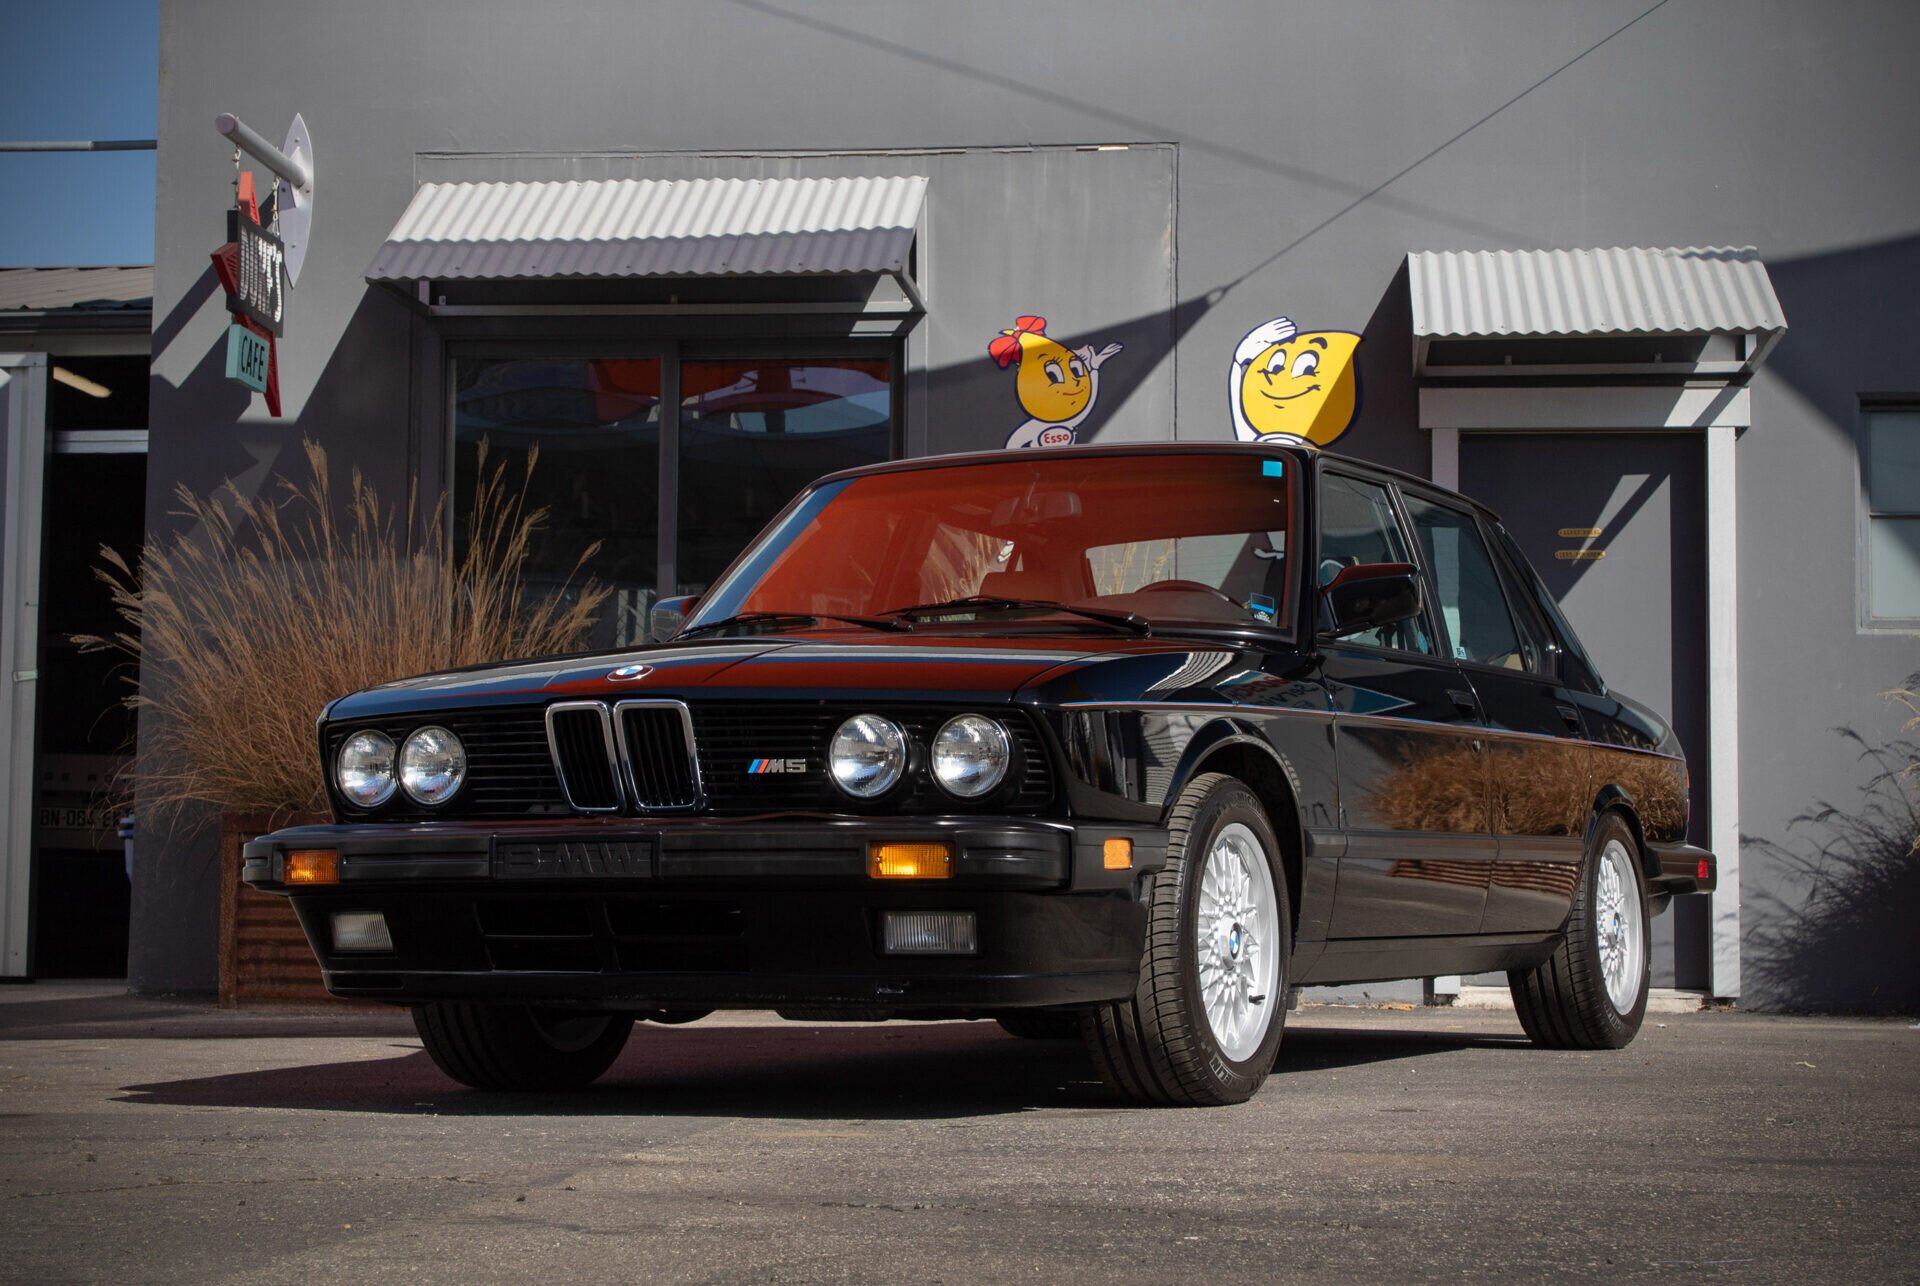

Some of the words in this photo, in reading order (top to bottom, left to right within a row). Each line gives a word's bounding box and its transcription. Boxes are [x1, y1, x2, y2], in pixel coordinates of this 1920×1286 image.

[241, 335, 265, 382] CAFE
[1043, 432, 1070, 444] Esso
[763, 758, 807, 774] M5
[504, 843, 643, 875] BMW
